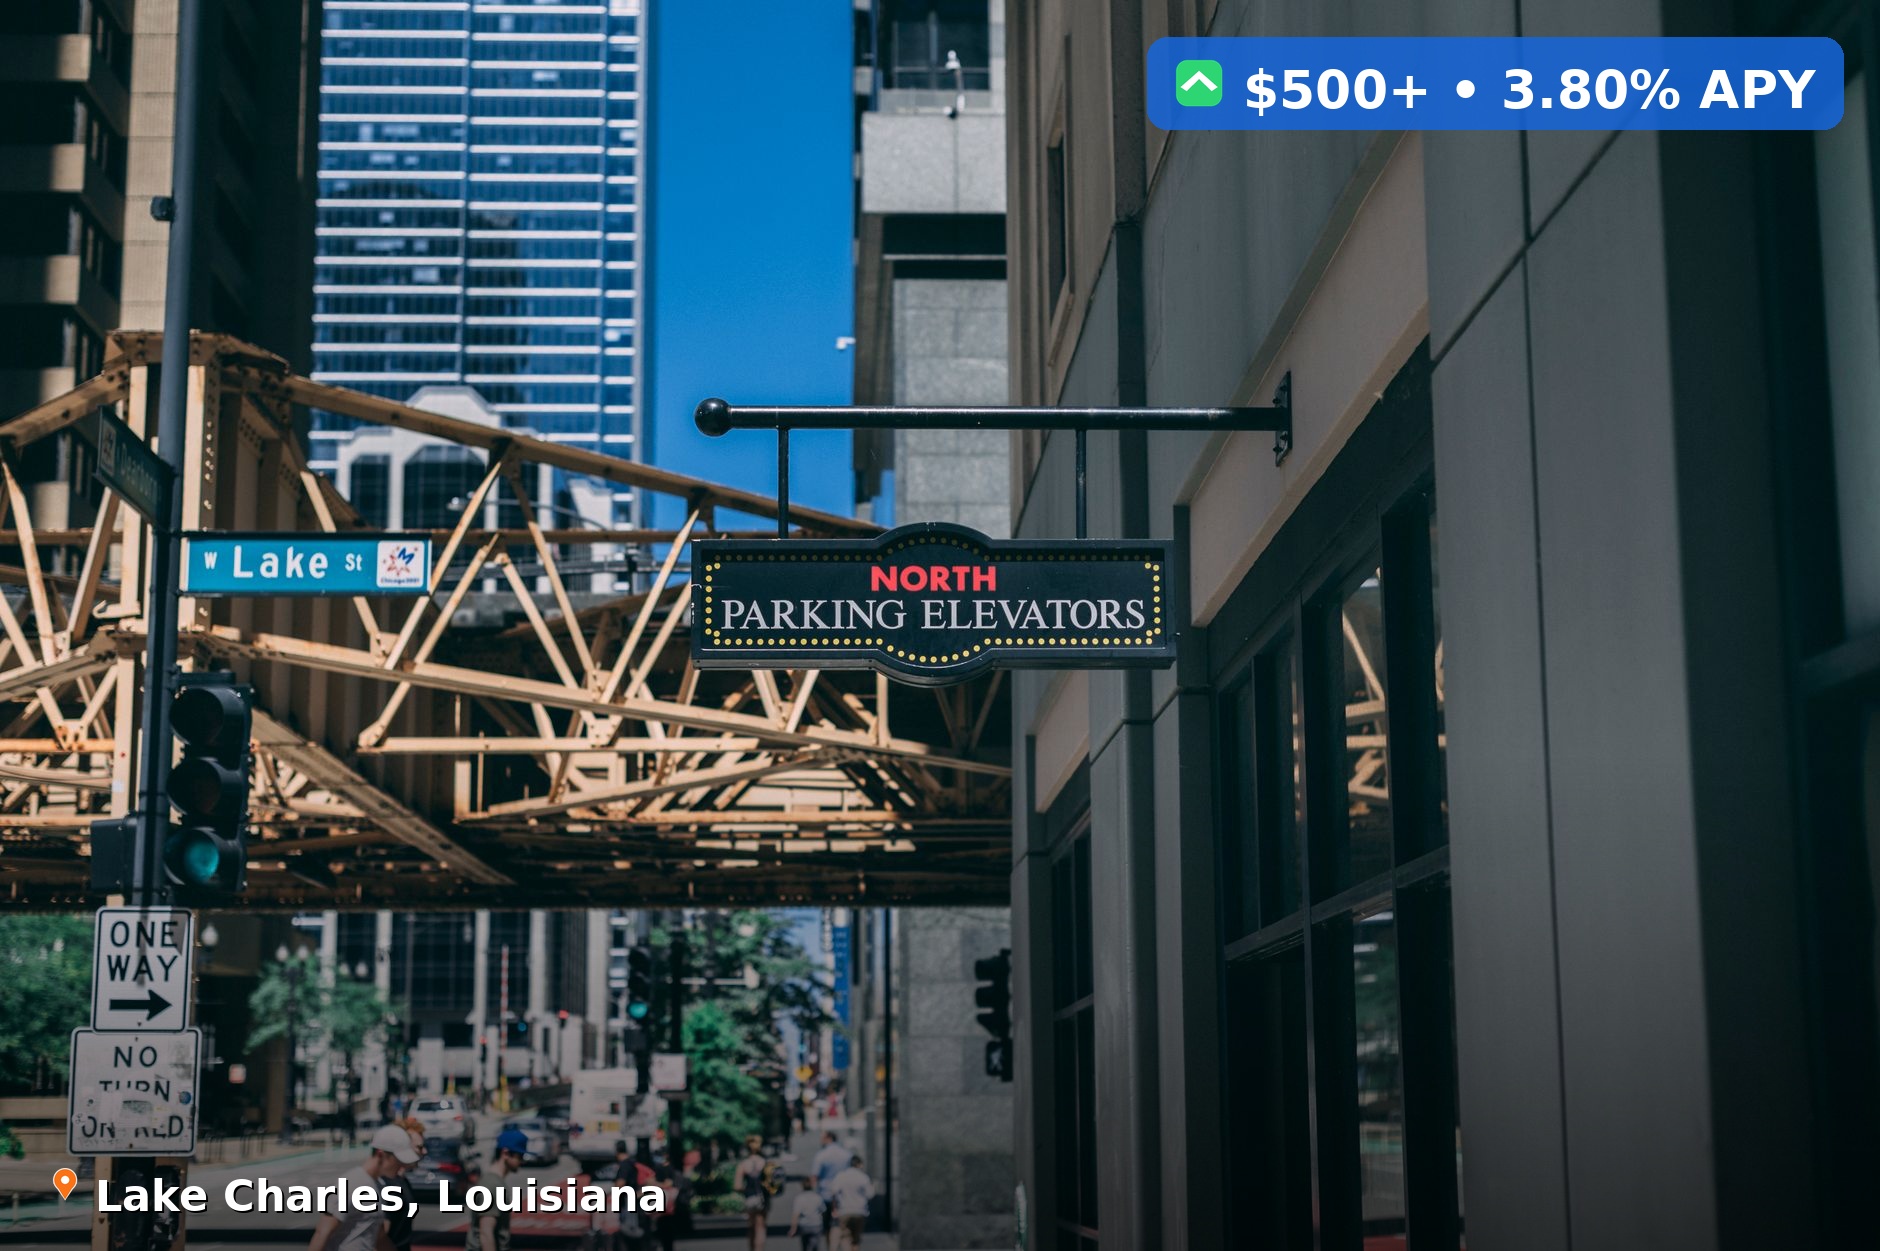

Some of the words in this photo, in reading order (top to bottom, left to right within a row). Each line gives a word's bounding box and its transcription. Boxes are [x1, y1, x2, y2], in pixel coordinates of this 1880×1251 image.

[204, 551, 218, 570] W
[233, 545, 329, 579] Lake
[344, 552, 363, 572] St
[870, 565, 997, 592] NORTH
[720, 599, 908, 631] PARKING
[920, 599, 1146, 631] ELEVATORS
[110, 920, 179, 949] ONE
[107, 954, 178, 982] WAY
[113, 1045, 158, 1068] NO
